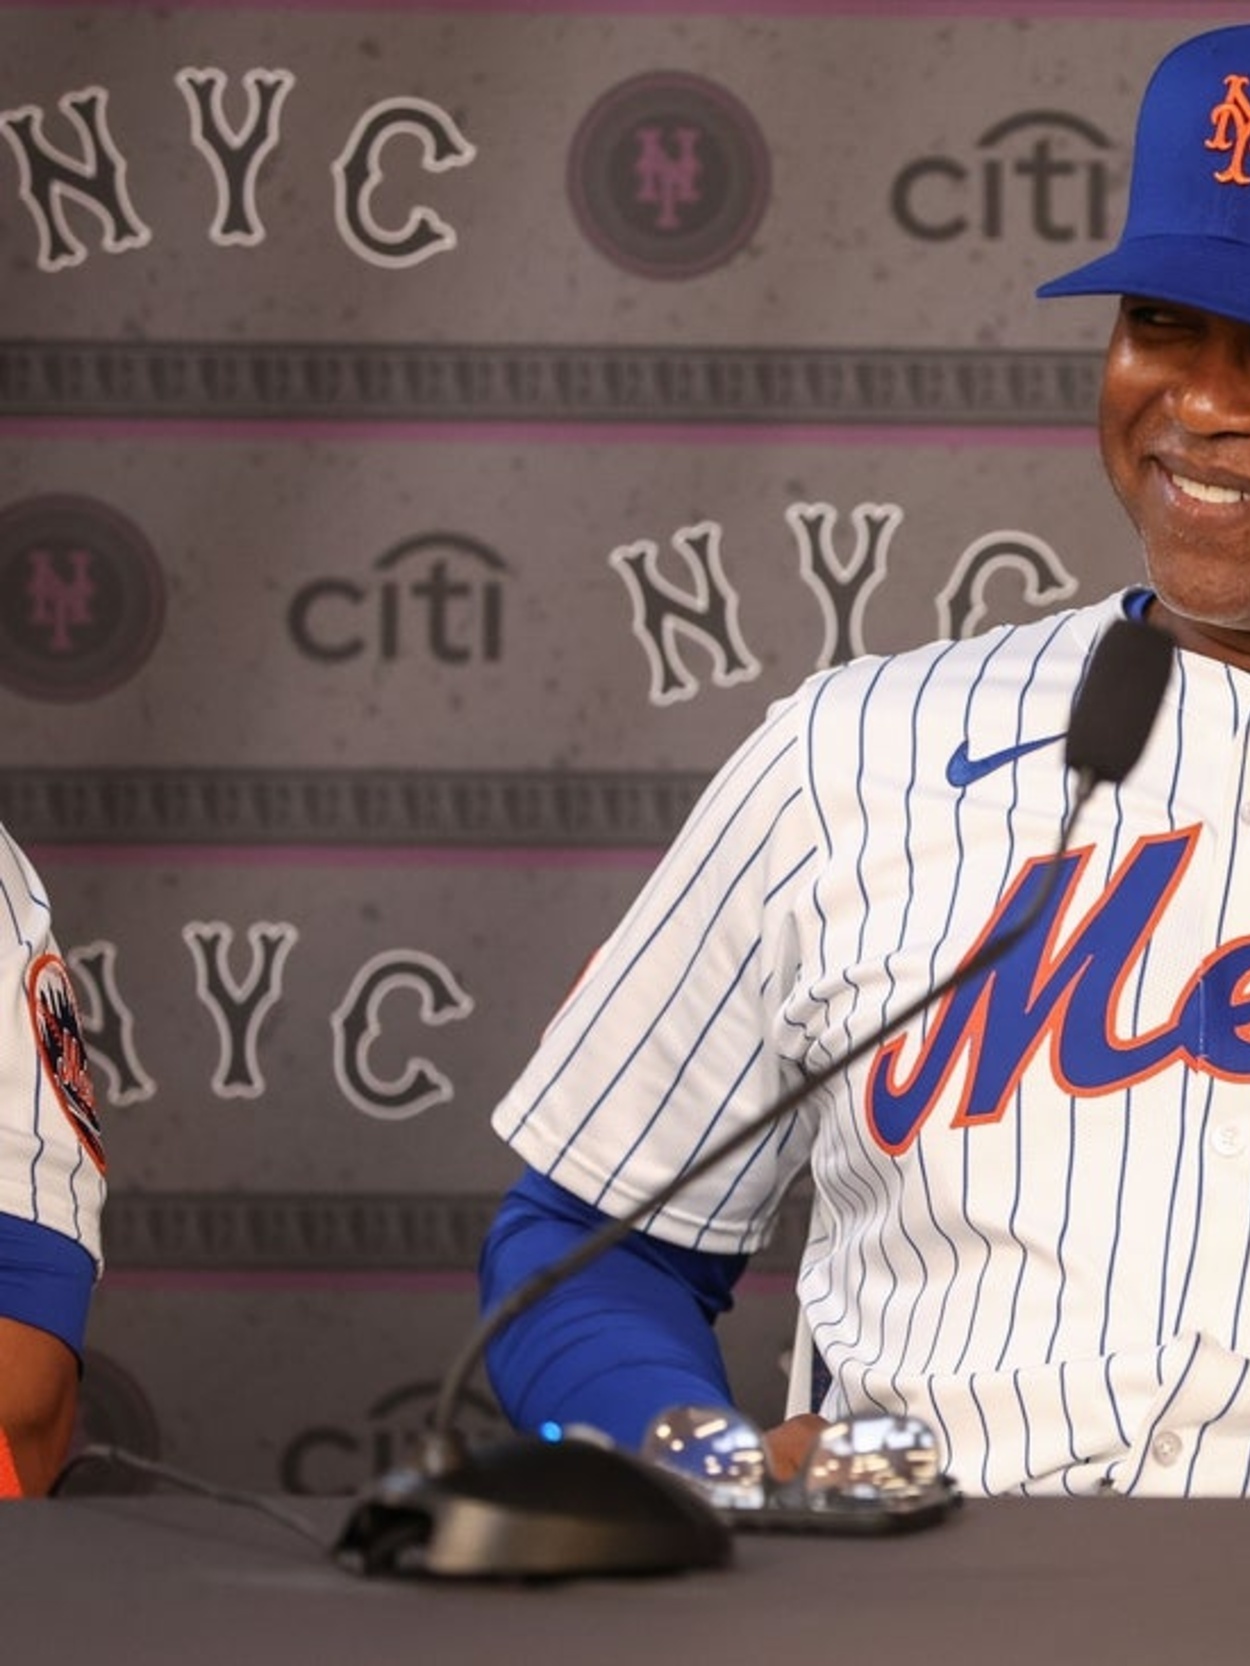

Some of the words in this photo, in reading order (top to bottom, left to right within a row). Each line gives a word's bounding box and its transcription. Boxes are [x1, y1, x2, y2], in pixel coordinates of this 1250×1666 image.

[0, 67, 476, 271] NYC
[889, 110, 1112, 243] citi
[286, 531, 510, 664] citi
